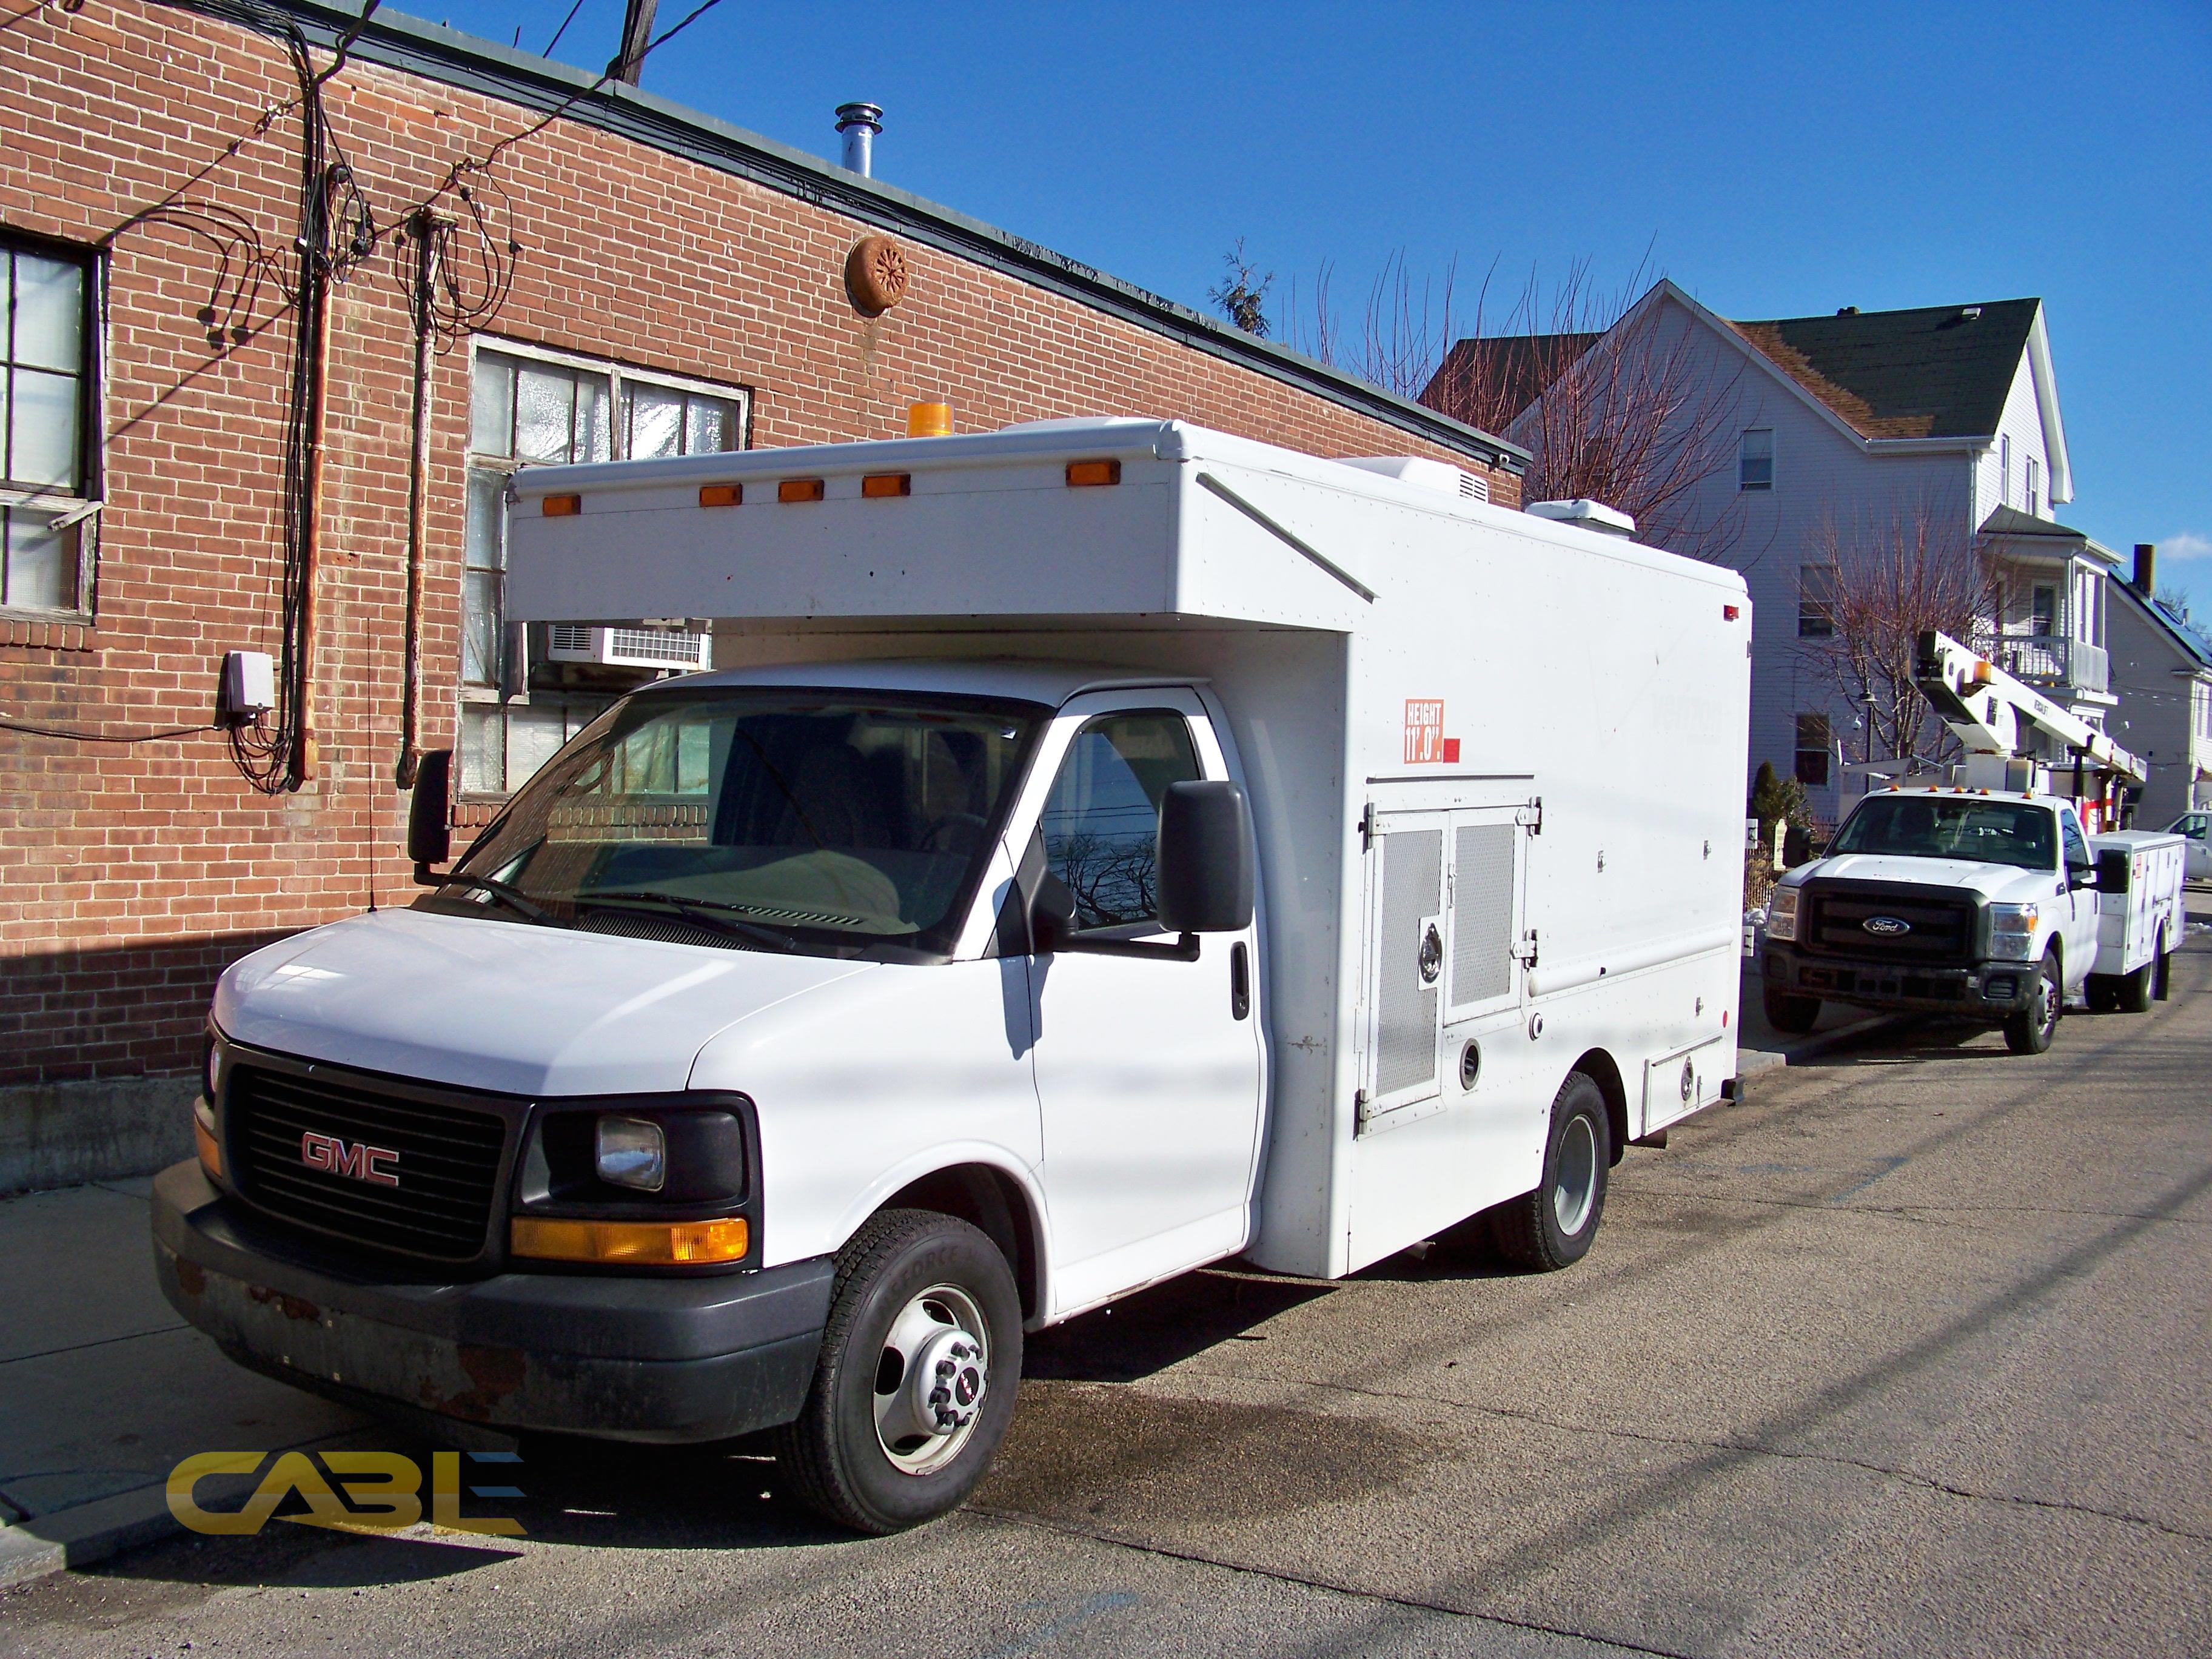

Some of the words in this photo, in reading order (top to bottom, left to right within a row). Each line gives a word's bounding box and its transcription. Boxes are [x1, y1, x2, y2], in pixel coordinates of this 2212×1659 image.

[1407, 702, 1442, 726] HEIGHT
[1872, 920, 1899, 932] Ford
[303, 1131, 400, 1187] GMC
